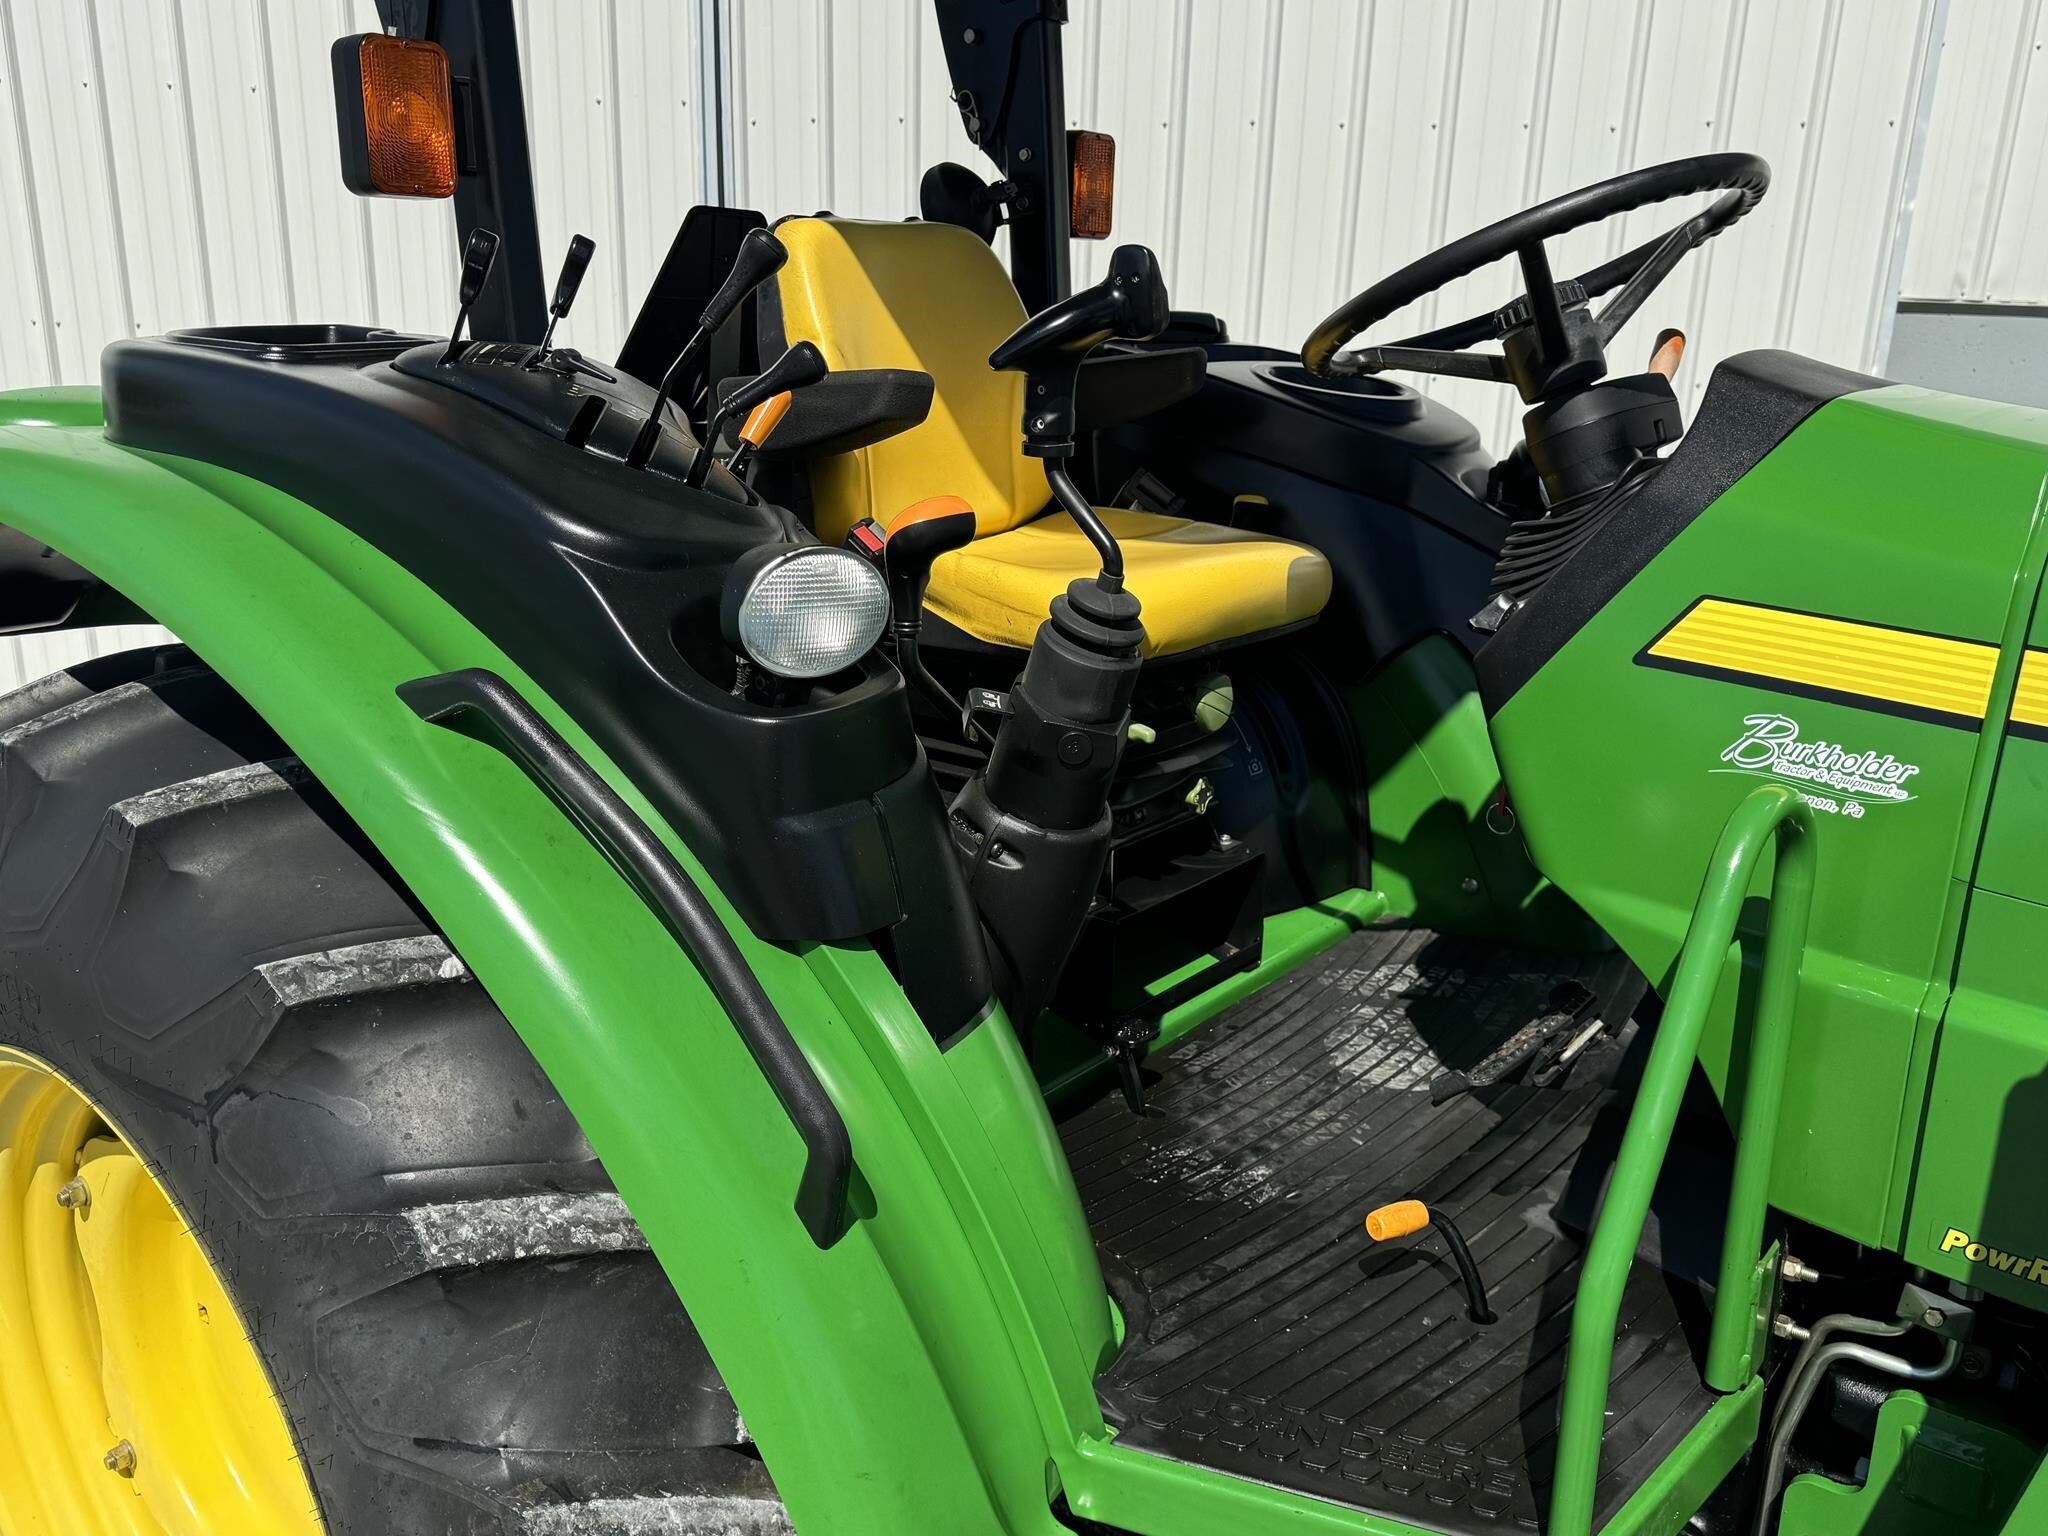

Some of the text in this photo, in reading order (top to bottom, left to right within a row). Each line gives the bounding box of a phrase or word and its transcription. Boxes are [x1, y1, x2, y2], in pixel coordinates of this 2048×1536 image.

[1721, 714, 1919, 783] Burkholder
[1772, 759, 1814, 779] Tractor
[1814, 768, 1828, 782] &
[1828, 771, 1897, 793] Equipment
[1841, 801, 1865, 818] Pa
[1192, 1394, 1518, 1497] JOHN DEERE
